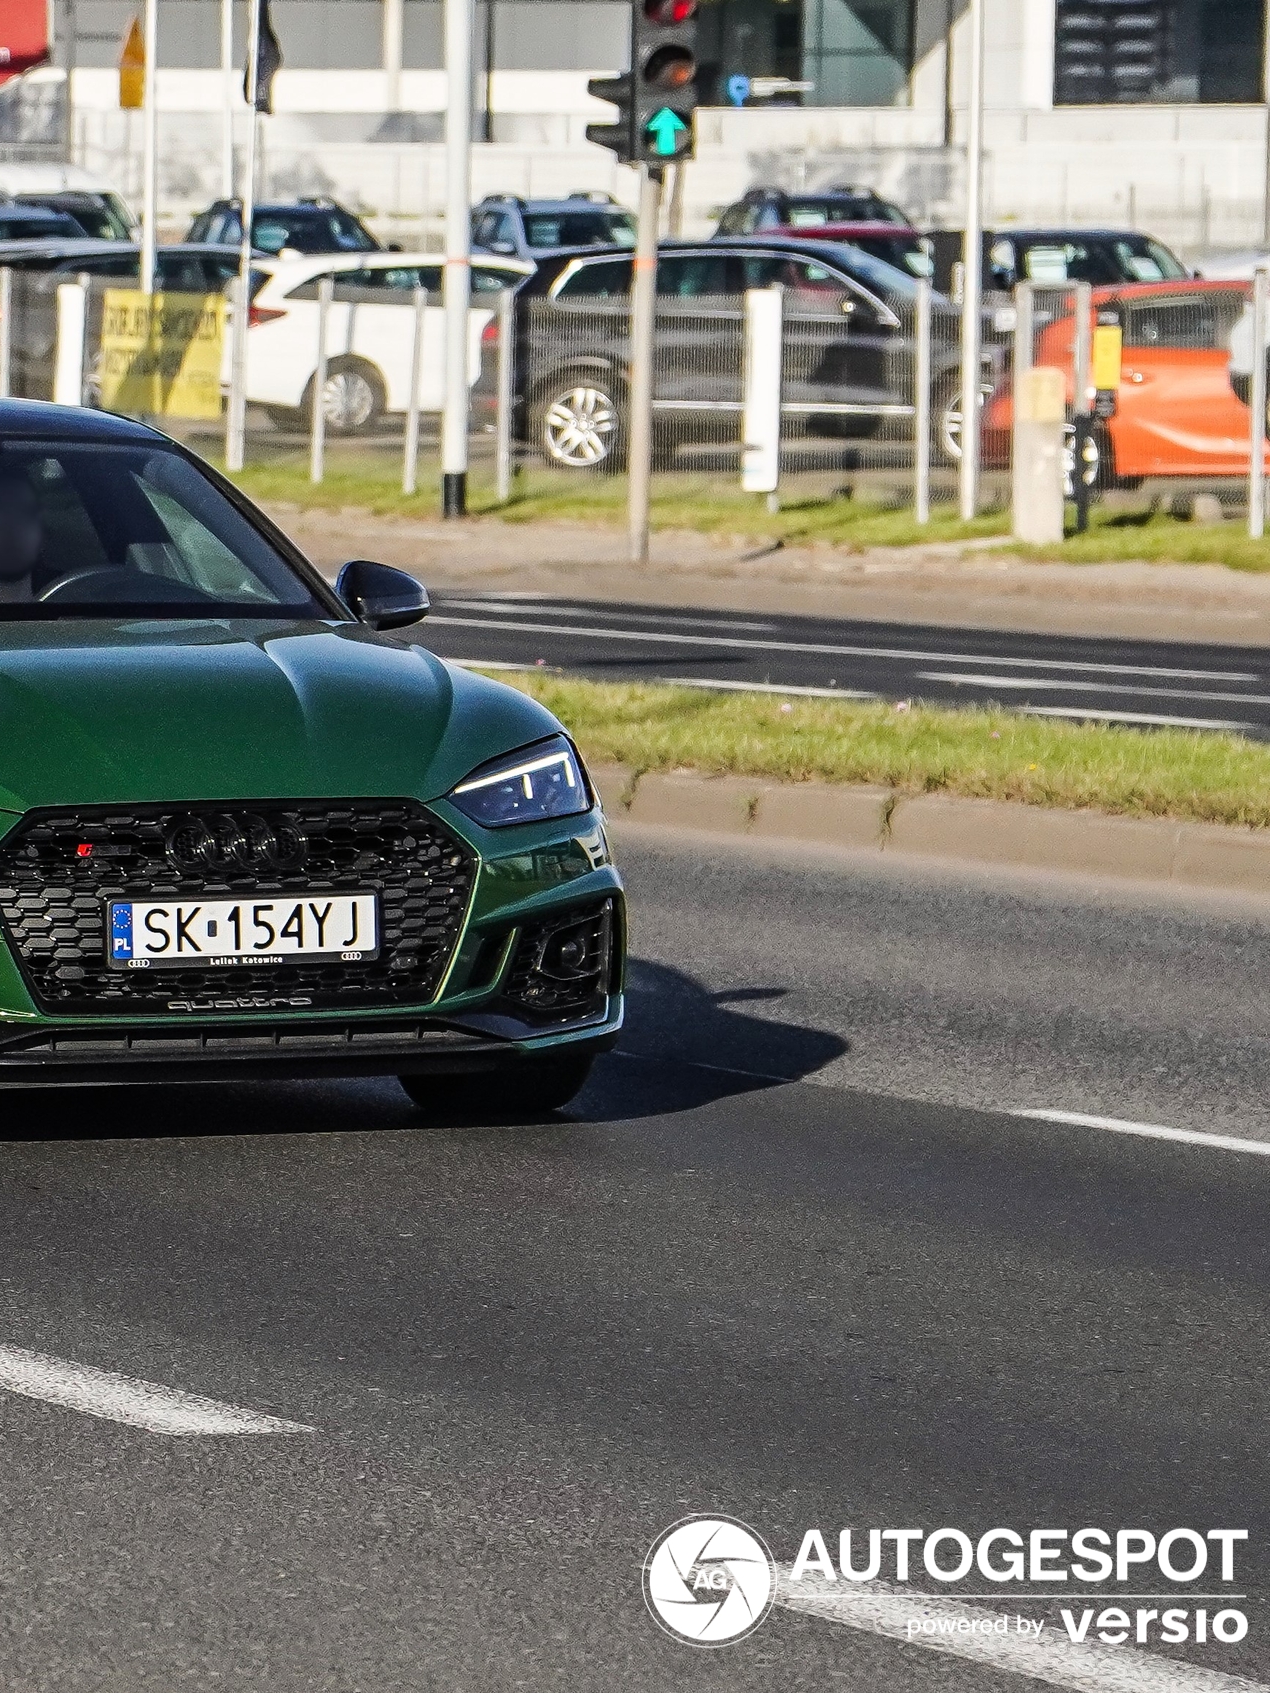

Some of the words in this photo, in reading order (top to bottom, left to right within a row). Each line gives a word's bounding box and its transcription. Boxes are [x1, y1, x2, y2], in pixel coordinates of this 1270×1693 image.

[144, 906, 202, 953] SK
[227, 901, 359, 951] 154YJ
[114, 938, 131, 951] PL
[242, 955, 284, 964] Katowice
[167, 997, 312, 1012] quattro
